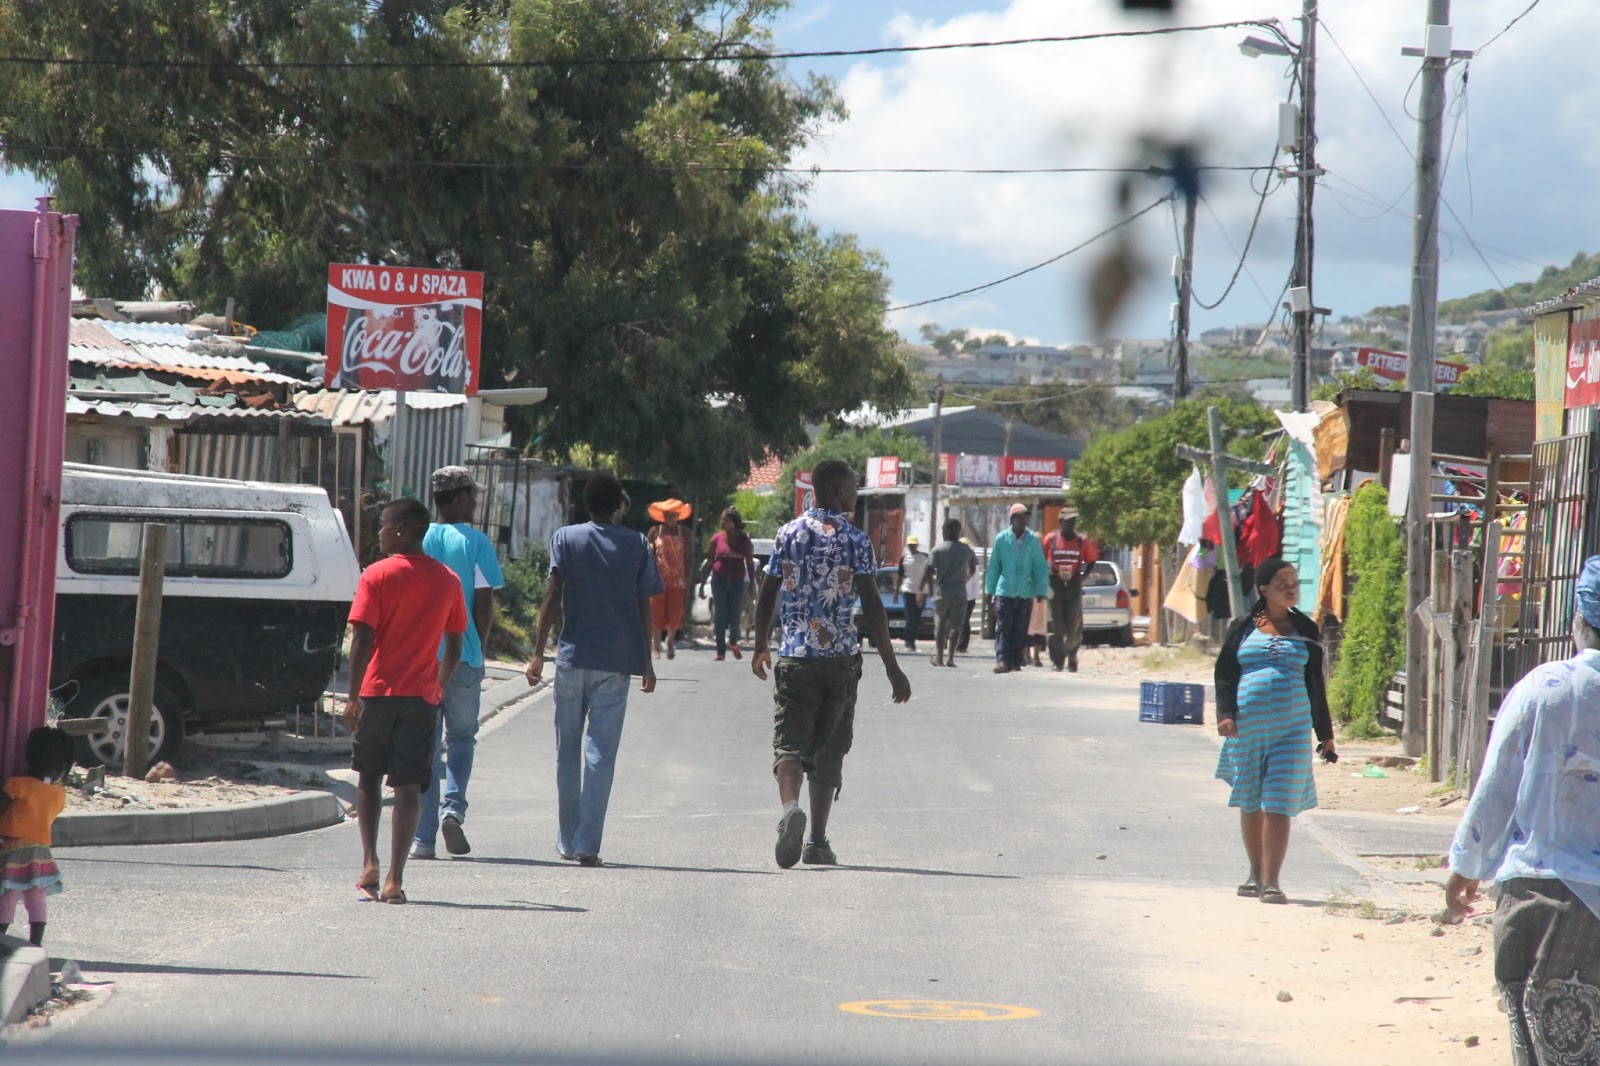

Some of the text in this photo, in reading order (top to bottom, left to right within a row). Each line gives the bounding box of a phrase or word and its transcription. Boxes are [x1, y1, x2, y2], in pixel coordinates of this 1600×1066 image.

[341, 268, 467, 296] KWA O & J SPAZA
[342, 316, 465, 377] Coca-Cola
[1367, 352, 1408, 373] EXTREM
[1013, 459, 1057, 473] MSIMANG
[1006, 473, 1062, 487] CASH STORE
